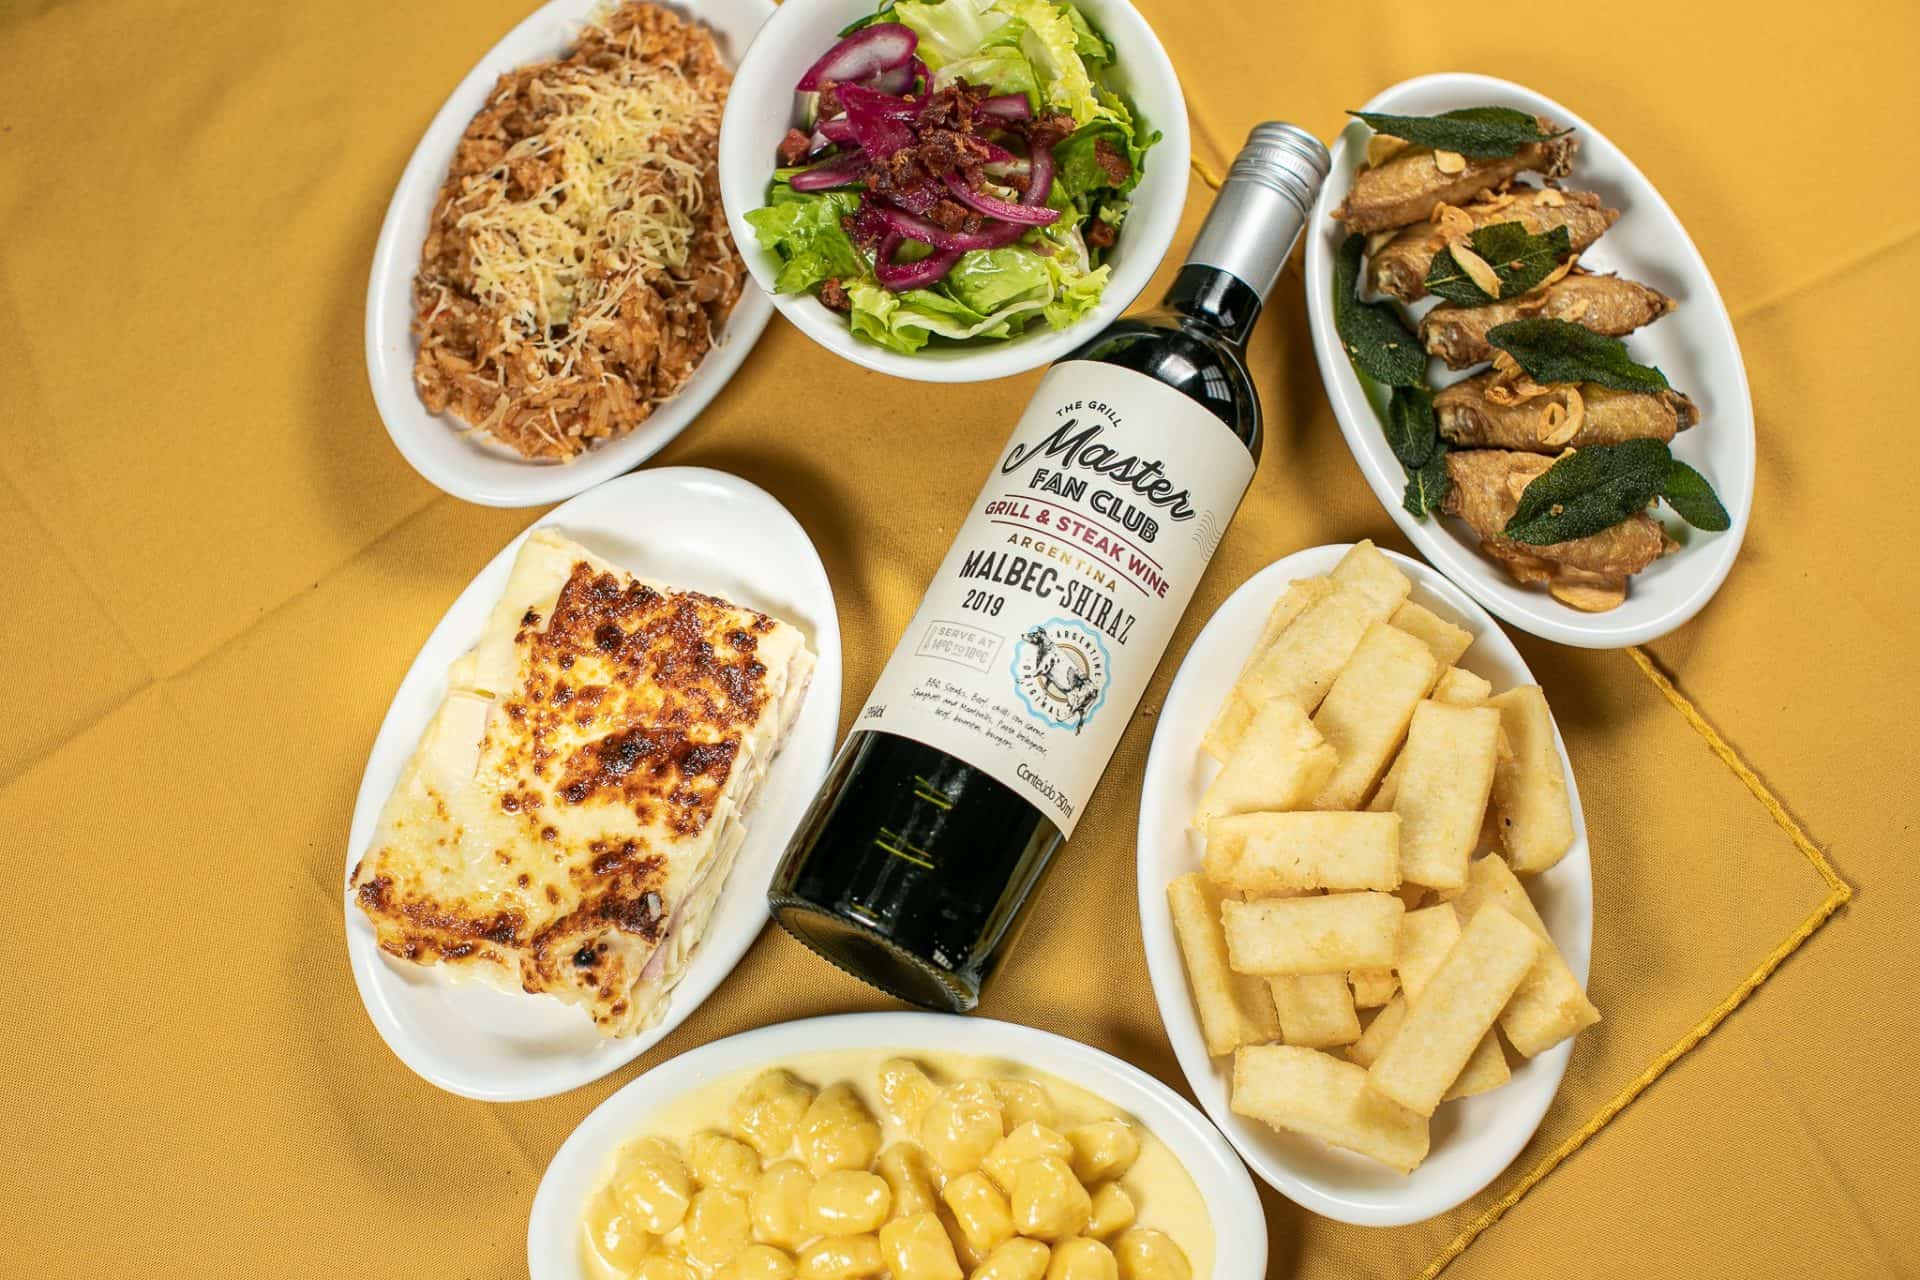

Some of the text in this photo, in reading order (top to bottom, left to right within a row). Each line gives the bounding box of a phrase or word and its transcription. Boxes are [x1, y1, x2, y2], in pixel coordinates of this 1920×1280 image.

[1056, 400, 1123, 428] THE GRILL
[1001, 418, 1196, 522] Master
[1029, 468, 1159, 543] FAN CLUB
[985, 501, 1170, 599] GRILL & STEAK WINE
[1007, 533, 1117, 592] ARGENTINA
[959, 550, 1136, 645] MALBEC-SHIRAZ
[962, 589, 1005, 617] 2019
[938, 627, 997, 649] SERVE AT
[1017, 763, 1056, 800] Conteúdo
